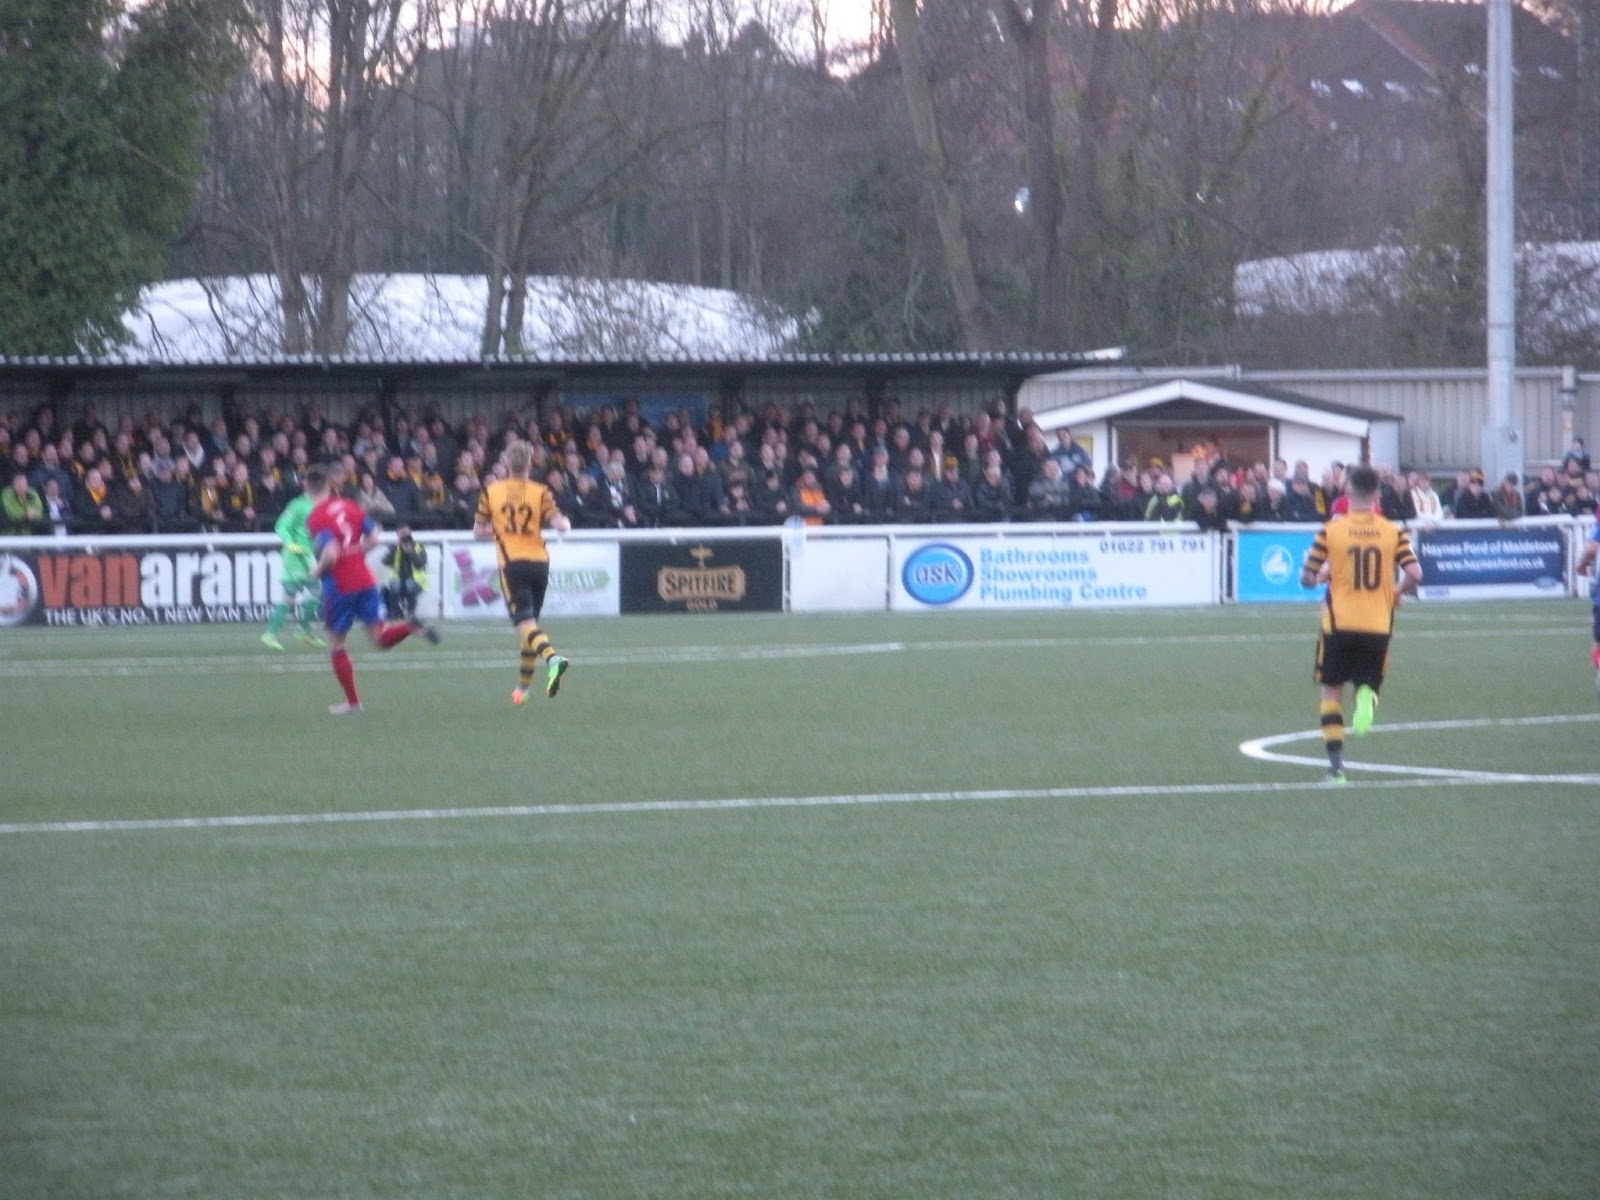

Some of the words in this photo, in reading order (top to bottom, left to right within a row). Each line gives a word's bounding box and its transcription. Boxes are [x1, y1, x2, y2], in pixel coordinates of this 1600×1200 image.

[500, 502, 533, 534] 32
[979, 546, 1089, 564] Bathrooms
[1100, 540, 1143, 553] 01622
[1150, 540, 1175, 553] 791
[1182, 539, 1205, 553] 791
[914, 562, 959, 584] ask
[979, 566, 1096, 583] Showrooms
[1347, 545, 1382, 591] 10
[38, 551, 285, 609] vanaram
[664, 572, 736, 596] SPITFIRE
[979, 584, 1072, 607] Plumbing
[1079, 583, 1147, 600] Centre
[43, 608, 76, 625] THE
[164, 606, 200, 624] NEW
[202, 605, 240, 623] VAN
